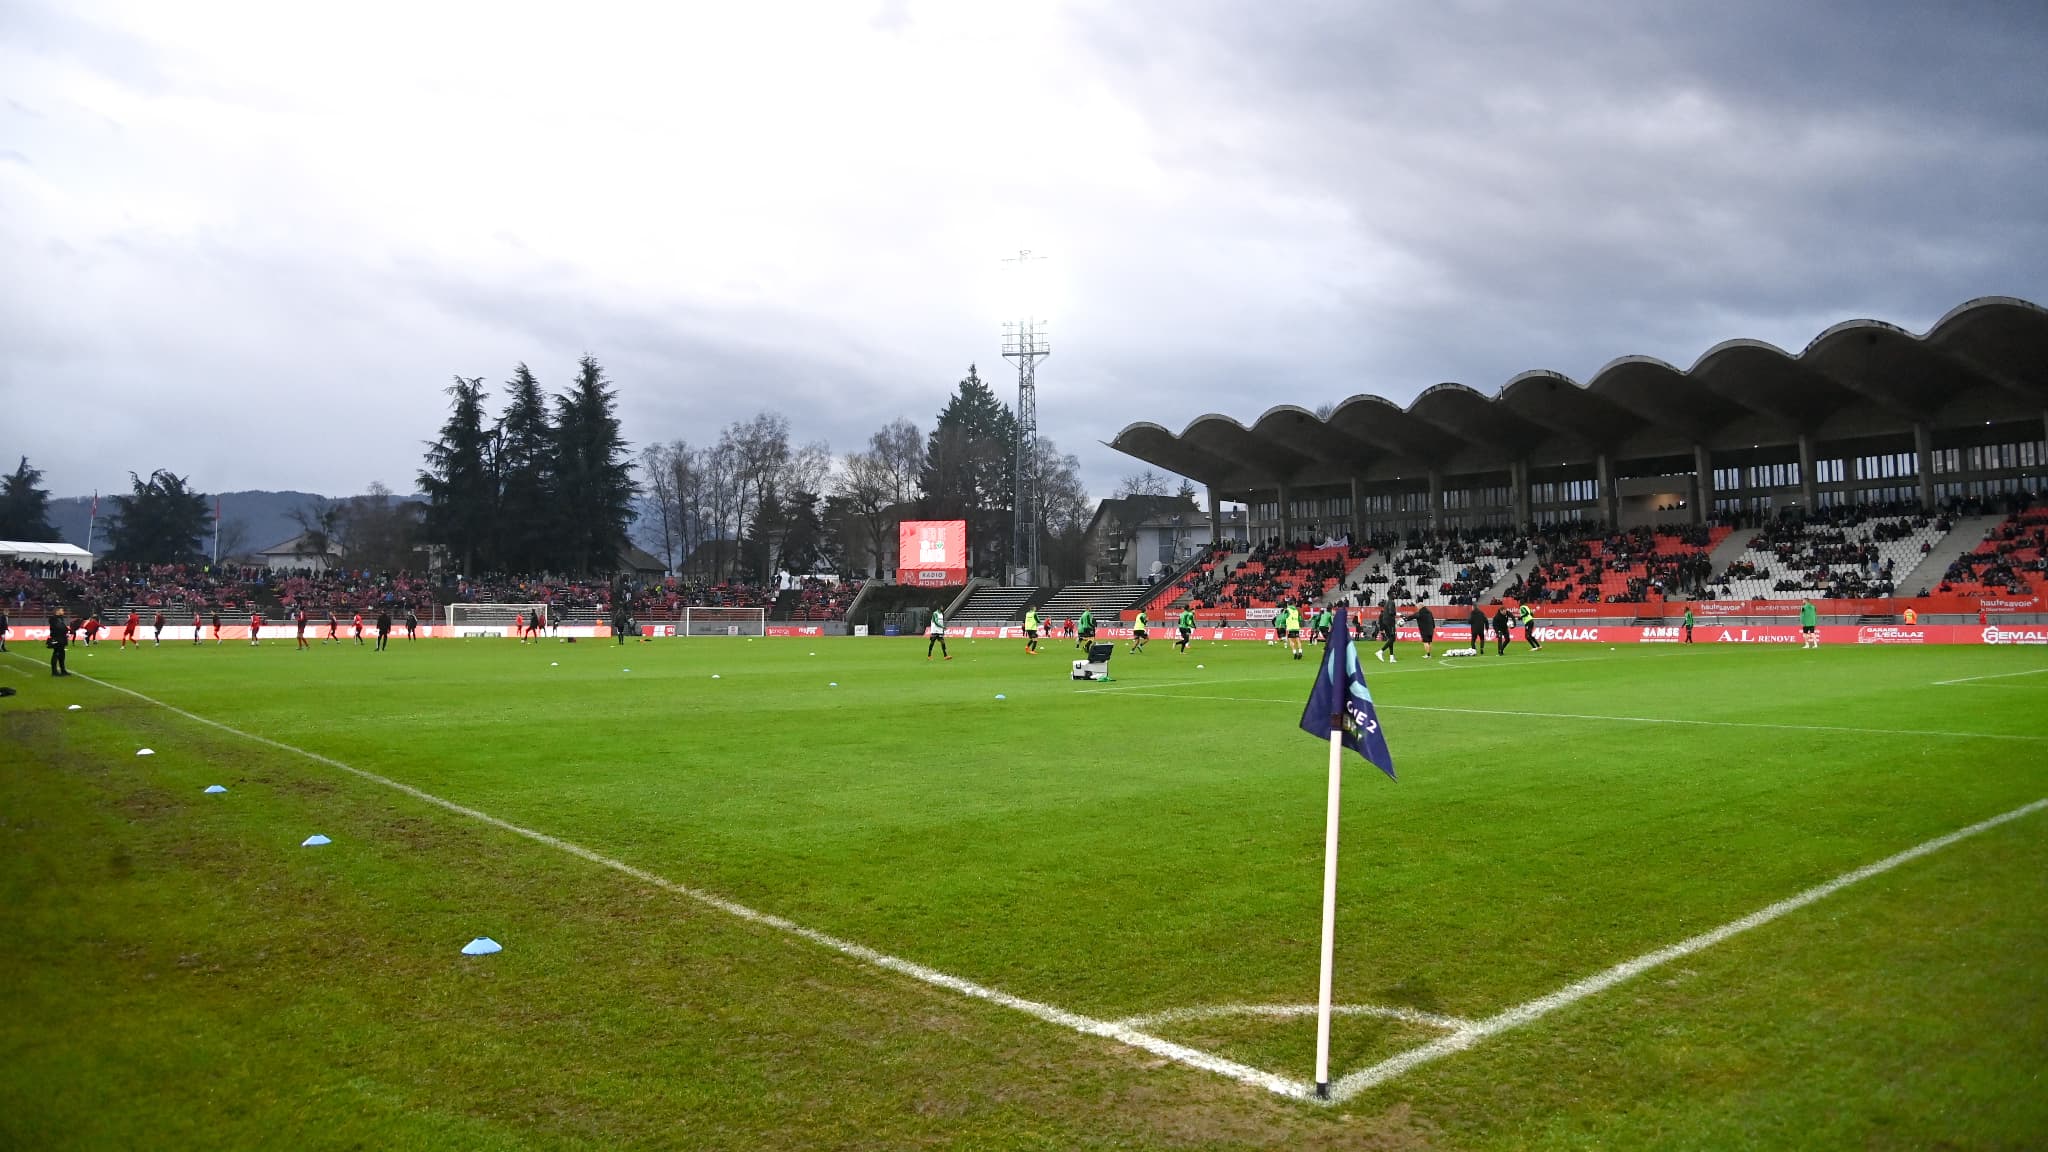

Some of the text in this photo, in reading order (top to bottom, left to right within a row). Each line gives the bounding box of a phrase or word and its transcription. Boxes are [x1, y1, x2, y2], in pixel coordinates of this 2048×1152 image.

[1107, 628, 1150, 637] NISSN
[1642, 627, 1680, 637] SAMSE
[1366, 719, 1377, 734] 2
